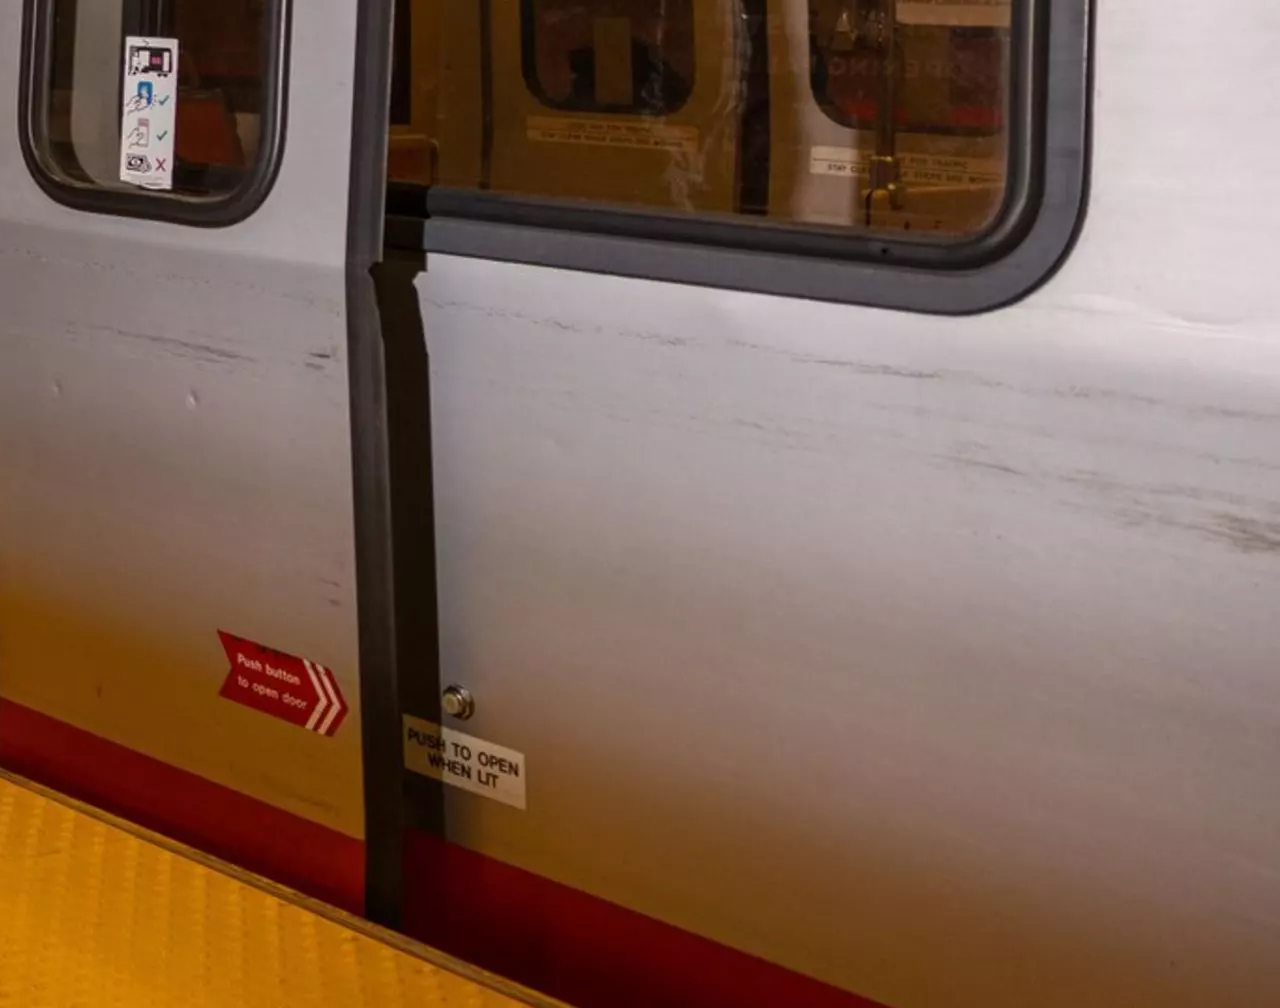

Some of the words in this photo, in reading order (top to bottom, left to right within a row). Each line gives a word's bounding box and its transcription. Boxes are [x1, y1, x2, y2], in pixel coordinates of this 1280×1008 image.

[236, 652, 263, 673] Push
[265, 663, 301, 686] button
[237, 674, 249, 689] to
[252, 682, 279, 700] open
[281, 692, 308, 710] door
[408, 727, 445, 753] PUSH
[451, 742, 471, 761] TO
[478, 751, 519, 778] OPEN
[427, 752, 471, 779] WHEN
[477, 769, 499, 788] LIT
